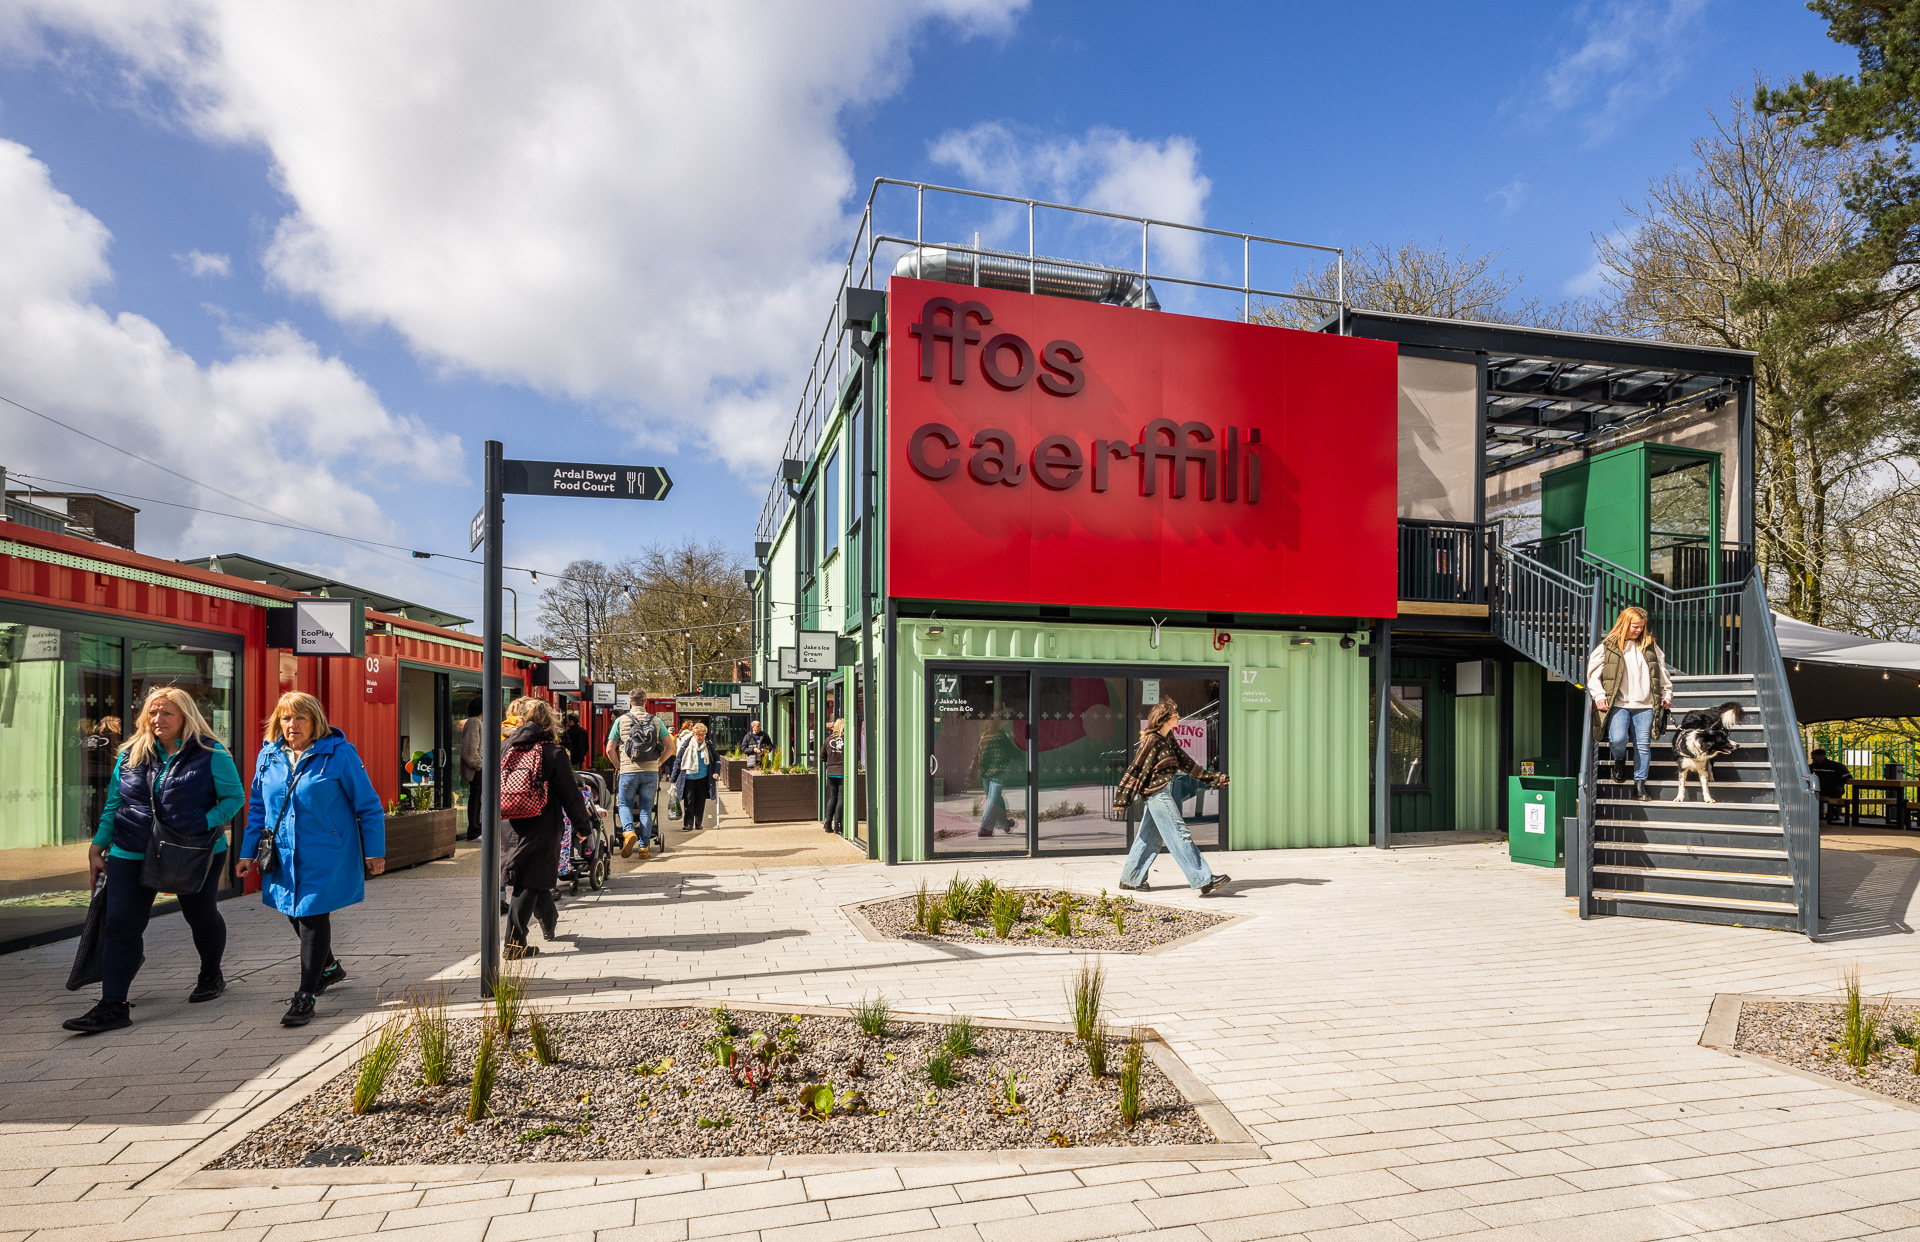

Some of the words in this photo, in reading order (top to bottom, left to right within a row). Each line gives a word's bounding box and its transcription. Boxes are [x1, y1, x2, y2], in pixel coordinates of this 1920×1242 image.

[908, 296, 1086, 397] ffos
[907, 417, 1261, 503] caerffili
[553, 468, 584, 479] Ardal
[586, 470, 617, 483] Bwyd
[553, 479, 580, 490] Food
[582, 481, 615, 492] Court
[301, 629, 334, 639] EcoPlay
[366, 656, 380, 673] 03
[1241, 670, 1258, 684] 17
[938, 678, 957, 693] 17
[417, 760, 431, 773] ice
